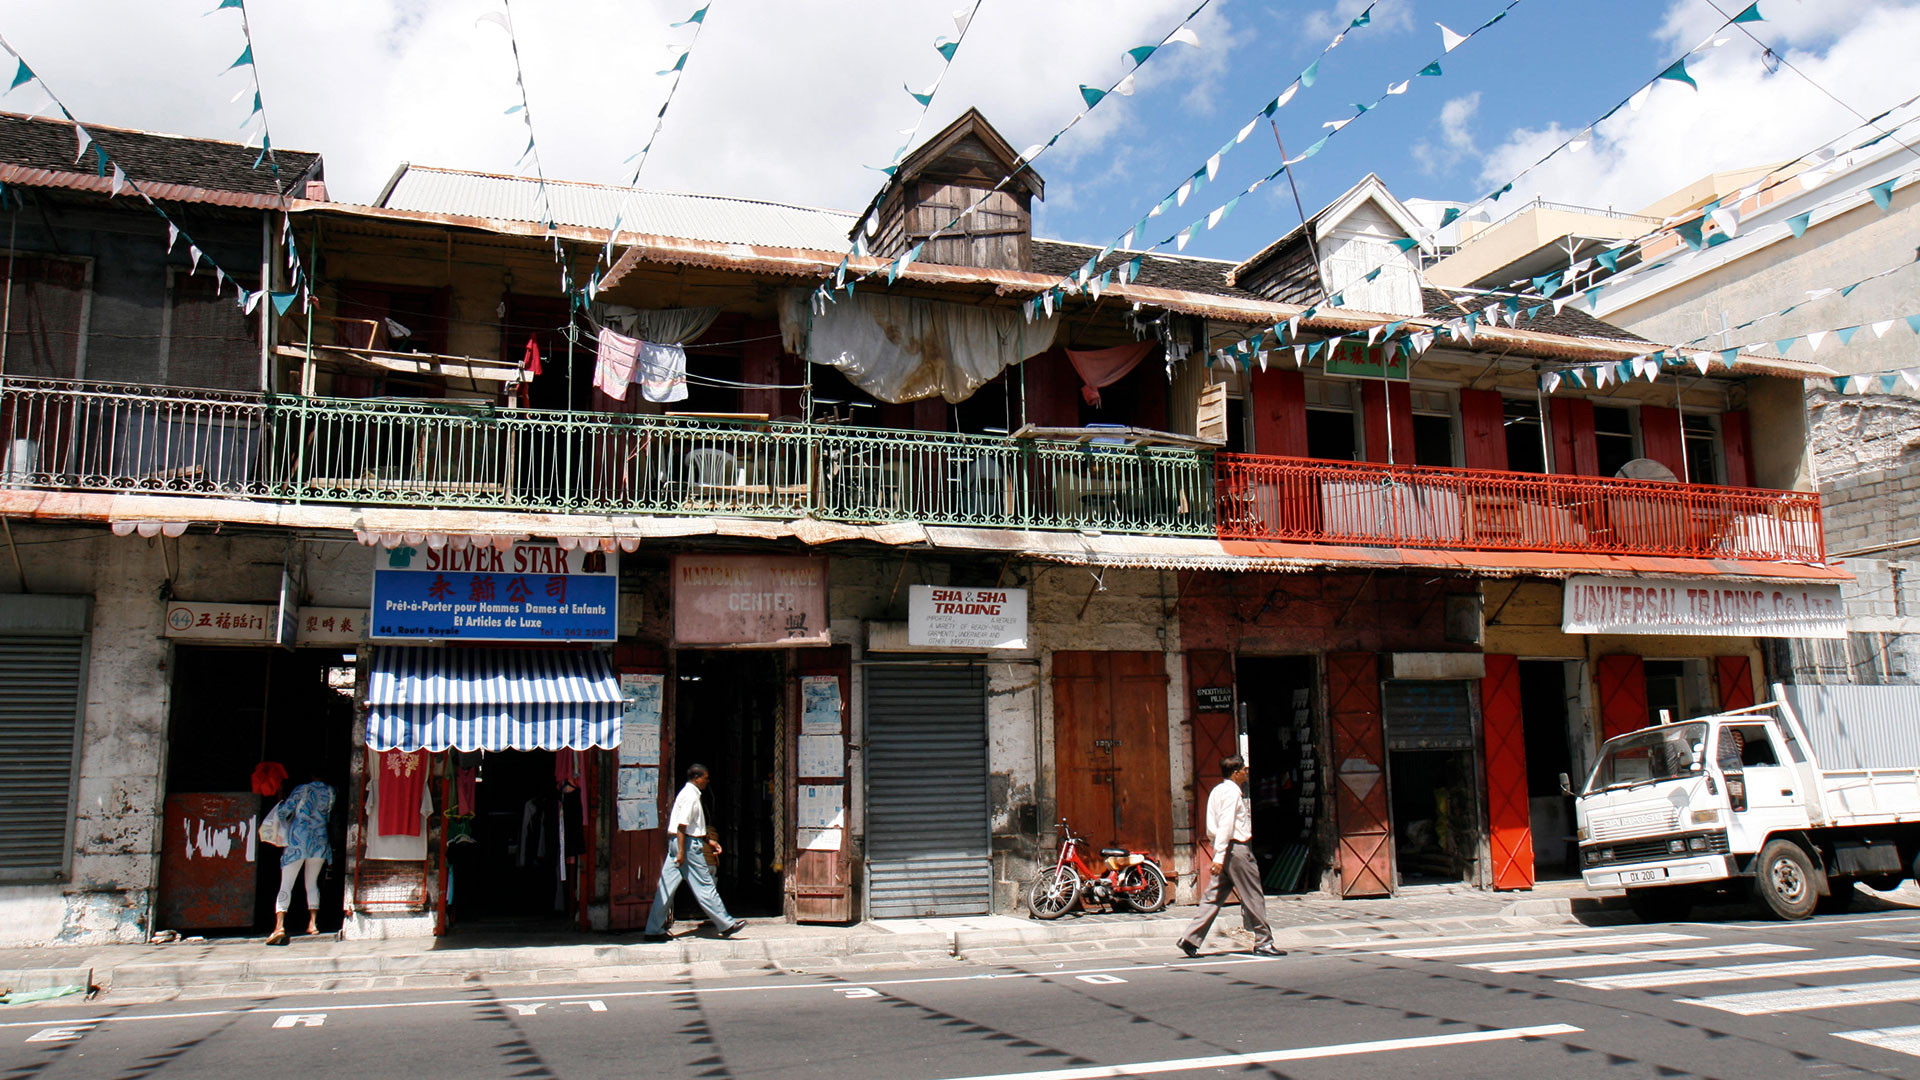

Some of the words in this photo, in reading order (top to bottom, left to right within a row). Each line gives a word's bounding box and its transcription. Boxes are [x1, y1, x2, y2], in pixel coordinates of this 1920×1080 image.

[426, 545, 504, 572] SILVER
[514, 546, 570, 574] STAR
[682, 567, 753, 586] NATIONAL
[728, 592, 795, 611] CENTER
[932, 590, 962, 602] SHA
[965, 591, 974, 603] &
[976, 591, 1007, 604] SHA
[385, 600, 453, 612] Prêt-à-Porter
[454, 603, 477, 614] pour
[479, 602, 519, 613] Hommes
[525, 603, 557, 614] Dames
[559, 604, 569, 614] et
[572, 603, 607, 615] Enfants
[935, 603, 1001, 615] TRADING
[1573, 585, 1678, 624] UNIVERSAL
[1687, 588, 1765, 626] TRADING
[171, 612, 191, 626] 44
[454, 616, 465, 627] Et
[465, 616, 502, 627] Articles
[505, 616, 517, 627] de
[520, 617, 542, 628] Luxe
[398, 626, 424, 635] Route
[428, 627, 459, 636] Royale
[541, 628, 553, 636] Tel
[1641, 870, 1655, 880] 200
